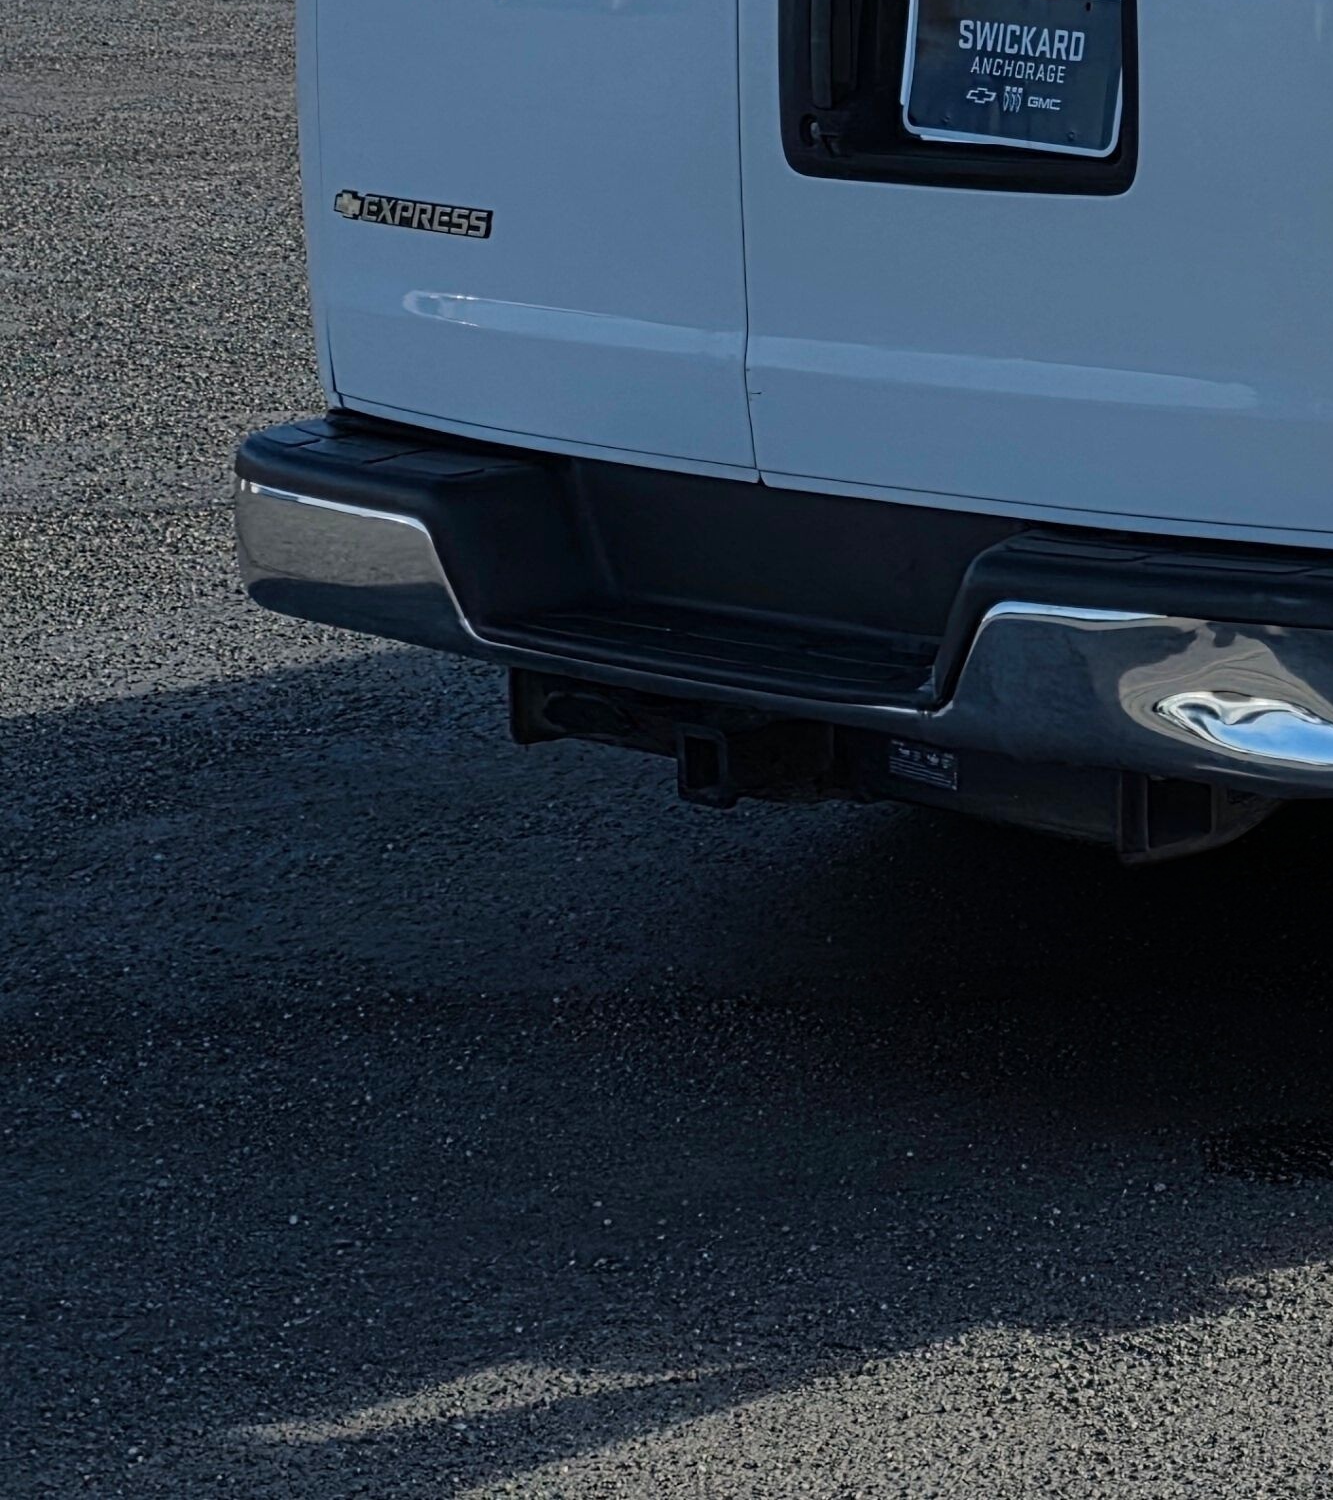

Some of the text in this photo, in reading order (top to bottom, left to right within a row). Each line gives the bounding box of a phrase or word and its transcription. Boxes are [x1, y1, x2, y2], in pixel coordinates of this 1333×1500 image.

[958, 19, 1086, 62] SWICKARD
[970, 56, 1067, 84] ANCHORAGE
[1027, 95, 1062, 111] GMC
[361, 195, 489, 238] EXPRESS
